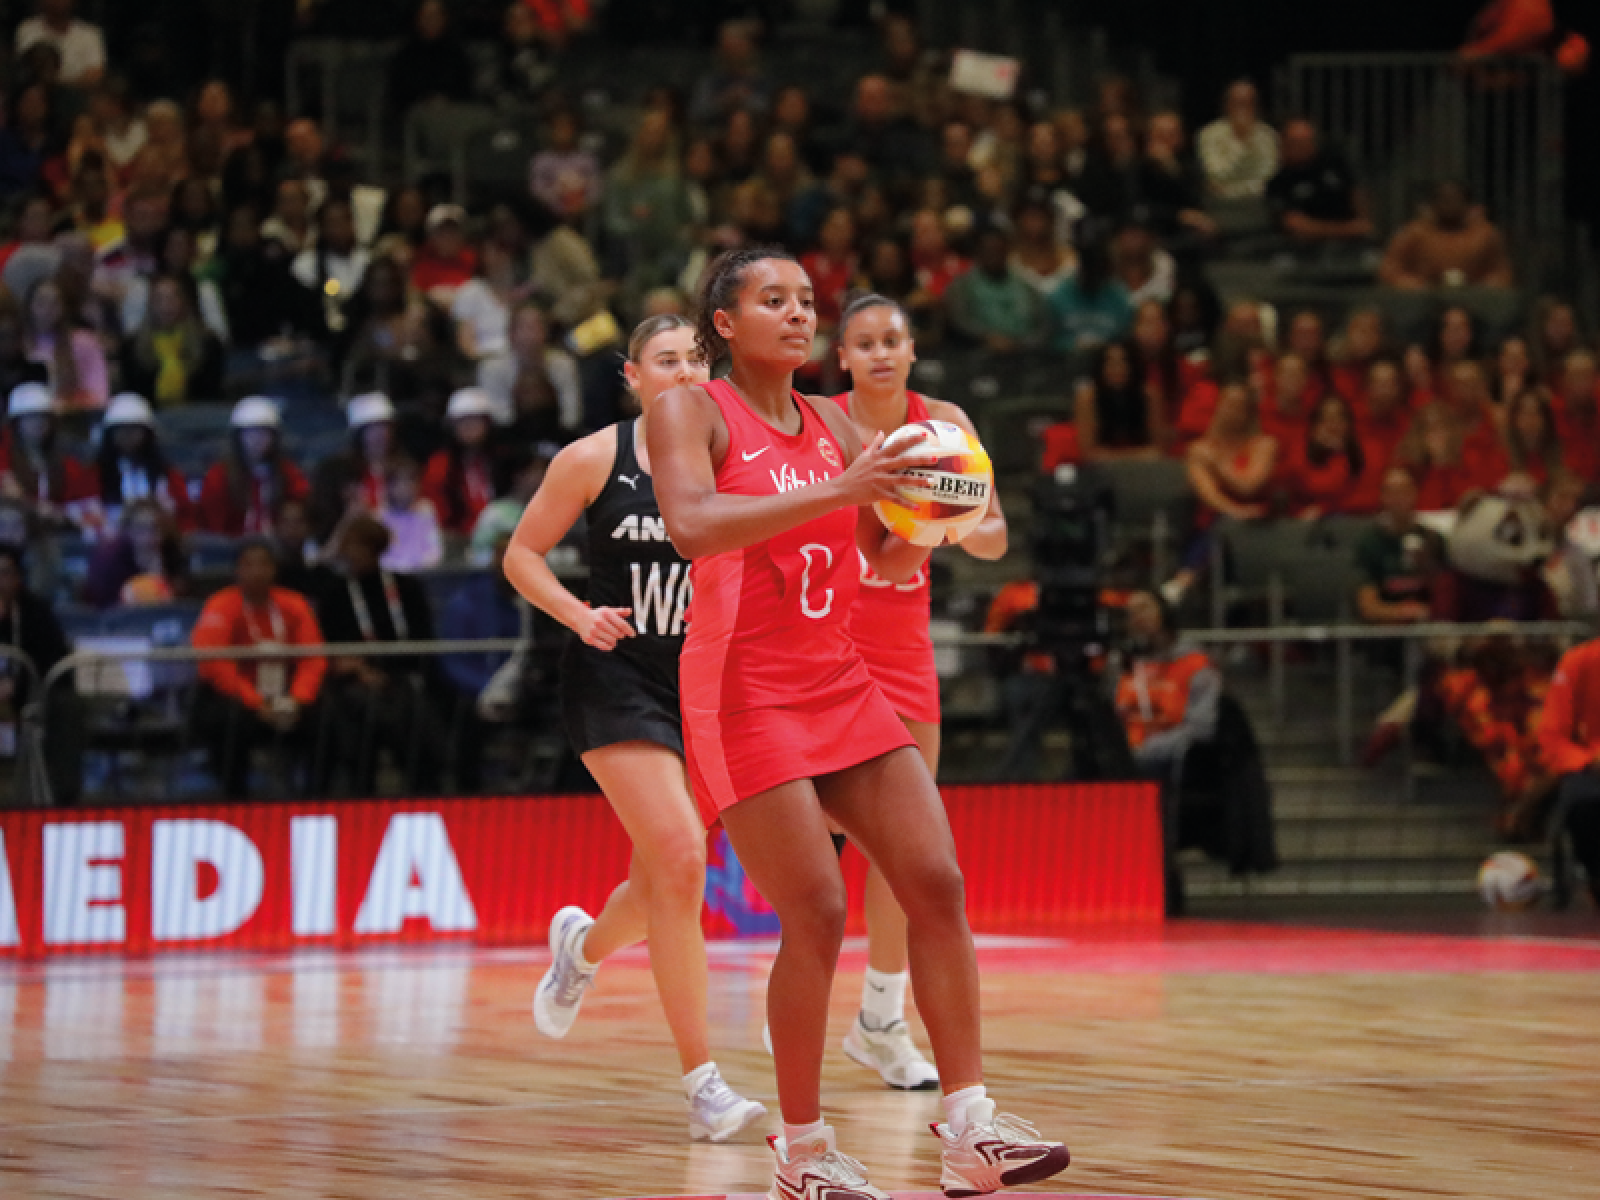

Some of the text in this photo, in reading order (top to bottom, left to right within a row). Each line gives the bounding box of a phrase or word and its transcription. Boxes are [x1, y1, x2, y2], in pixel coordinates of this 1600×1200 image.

[610, 513, 671, 542] AN
[800, 543, 833, 619] C
[0, 811, 478, 947] EDIA
